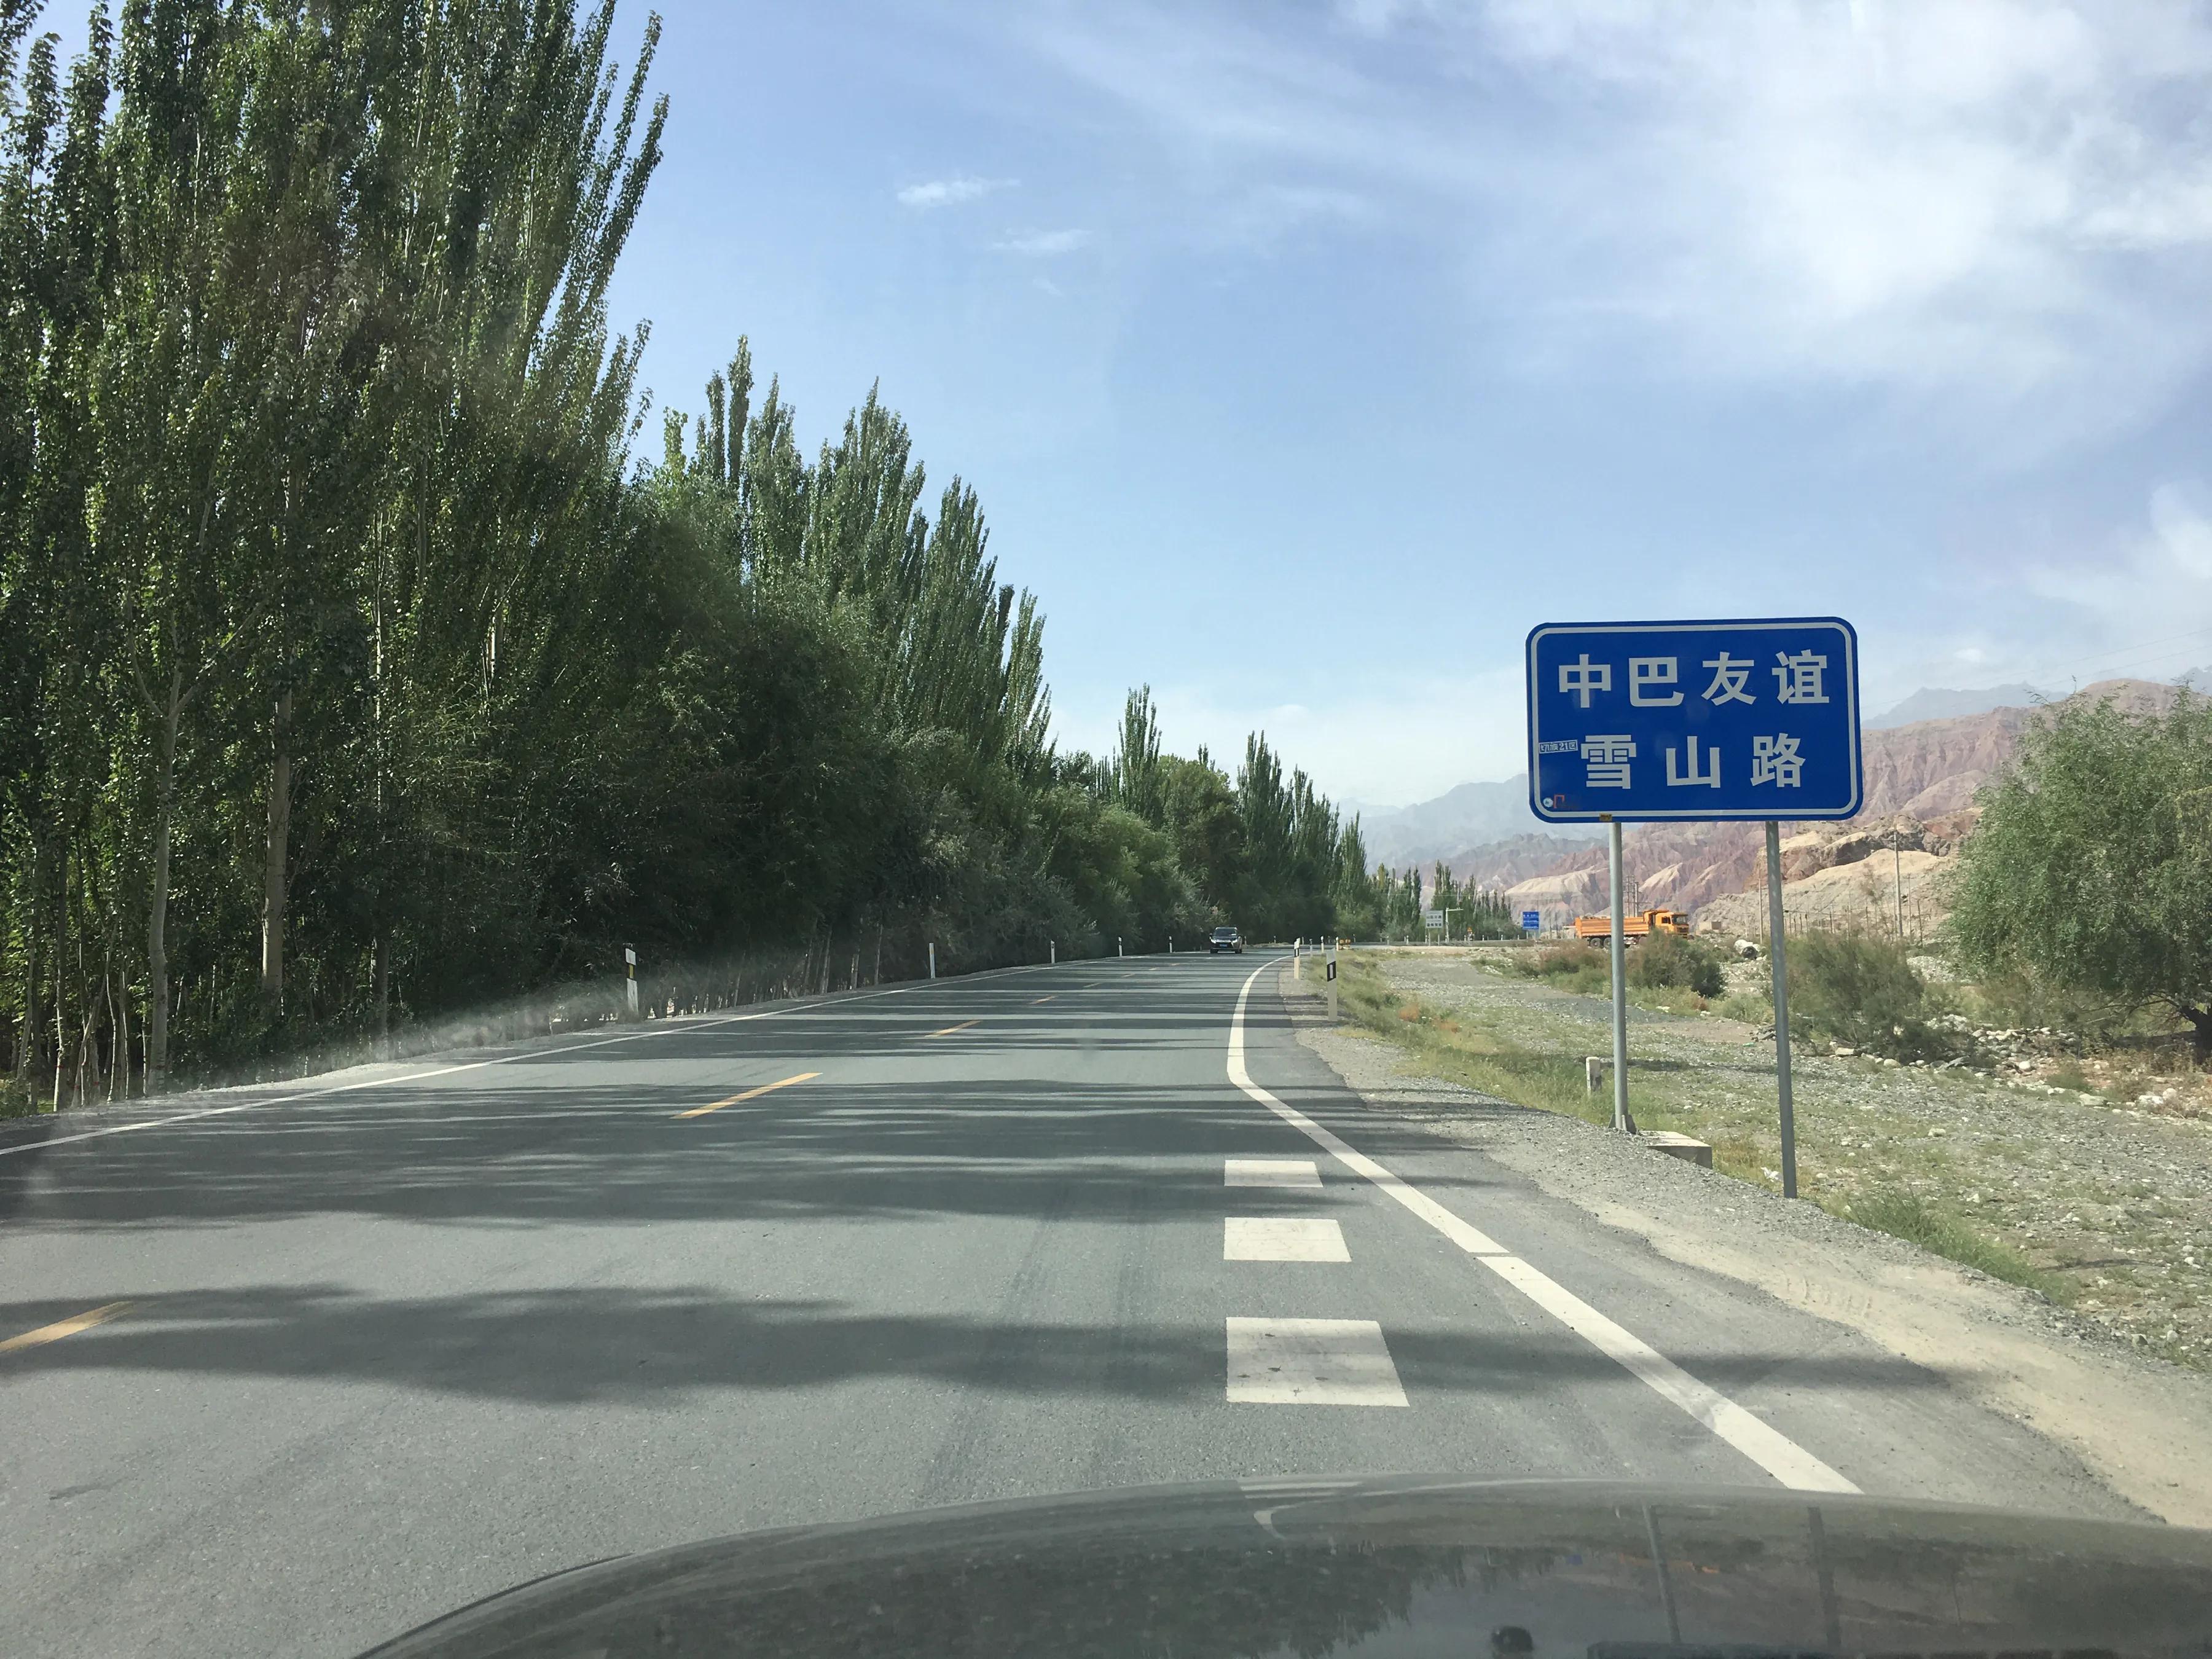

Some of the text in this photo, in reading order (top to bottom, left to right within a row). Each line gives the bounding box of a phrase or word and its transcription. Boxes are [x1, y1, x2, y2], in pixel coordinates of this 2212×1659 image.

[1558, 649, 1830, 708] 中巴友谊
[1580, 733, 1806, 790] 雪山路
